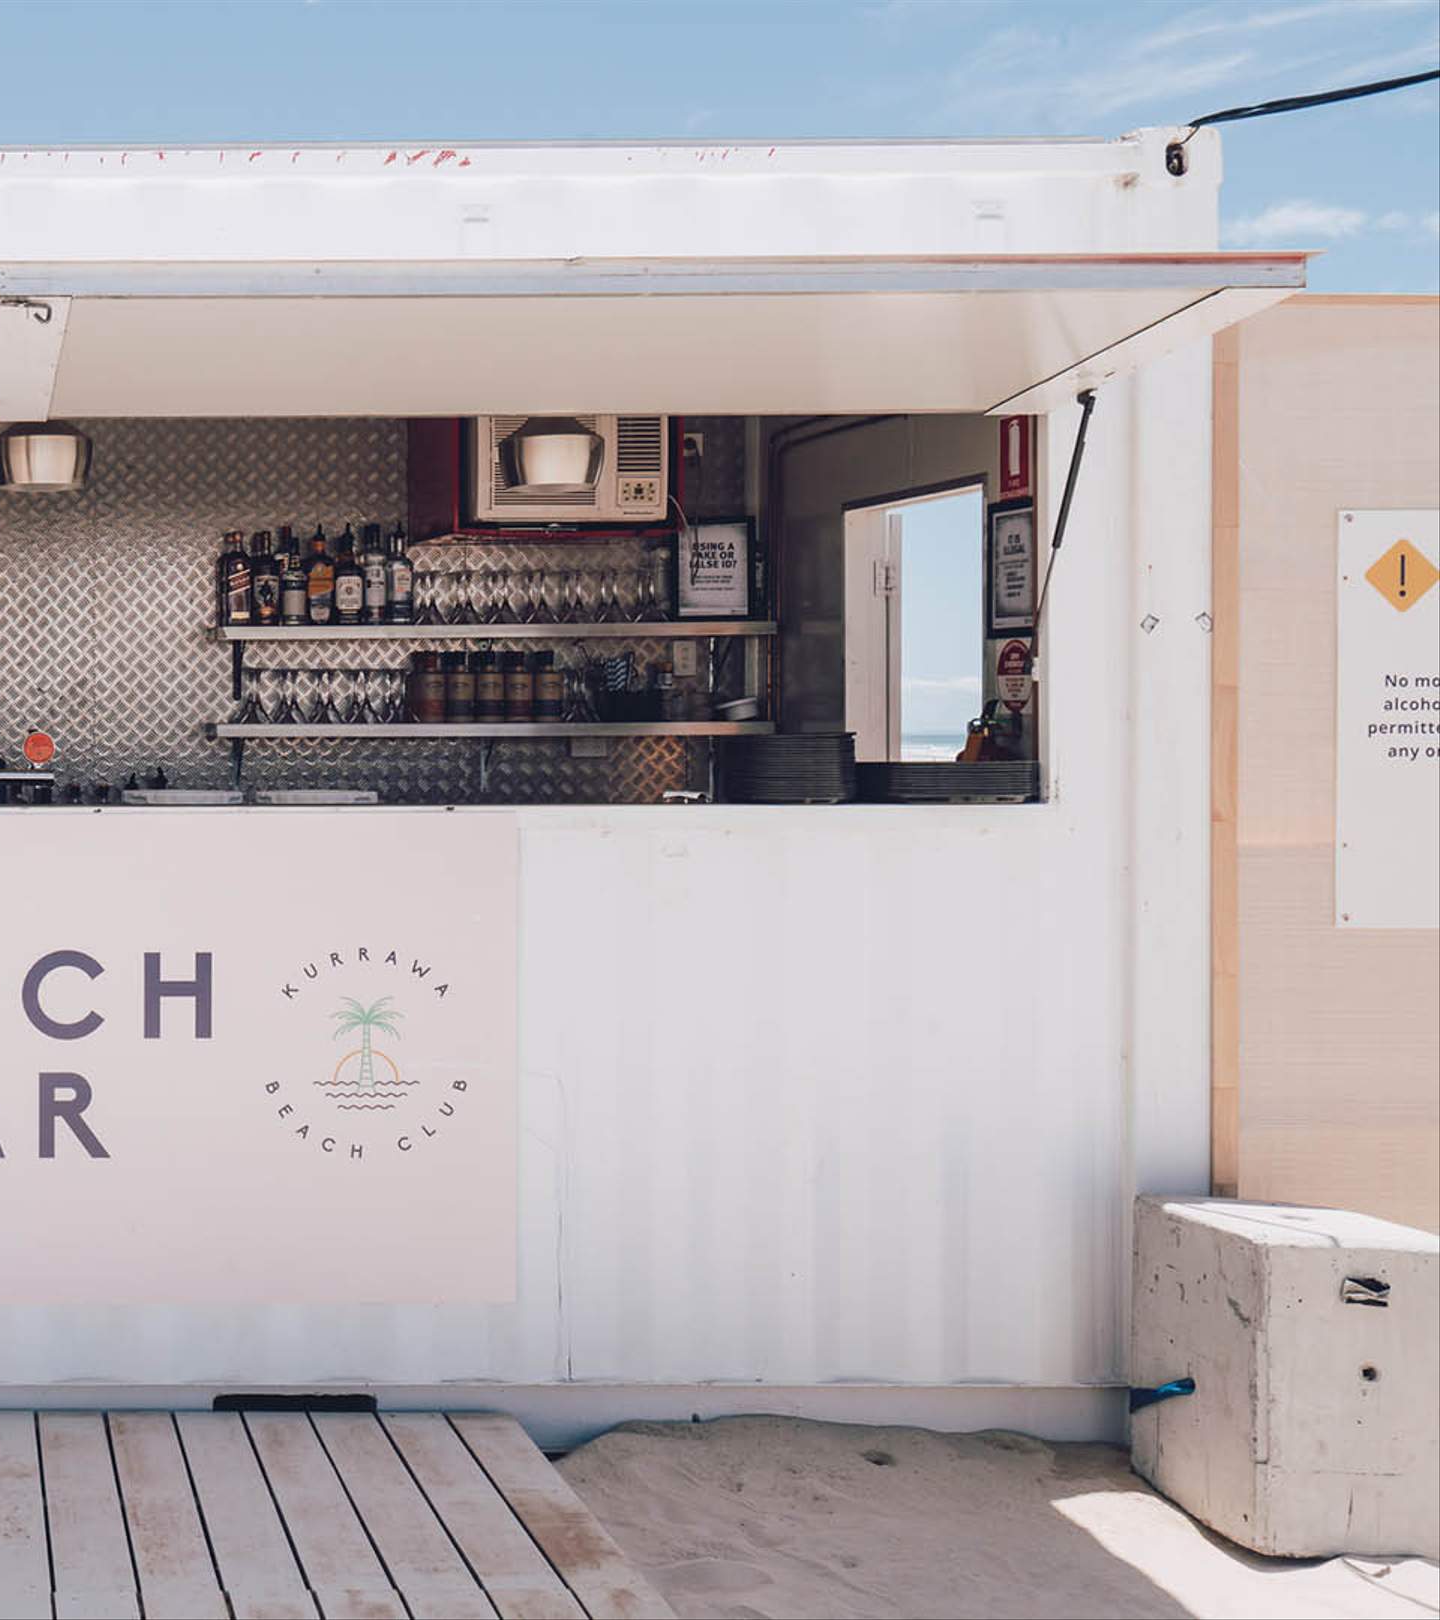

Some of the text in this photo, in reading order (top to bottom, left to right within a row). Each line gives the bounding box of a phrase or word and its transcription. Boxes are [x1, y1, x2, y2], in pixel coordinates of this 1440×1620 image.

[1385, 674, 1409, 688] No
[1388, 746, 1419, 761] any
[280, 947, 449, 999] KURRAWA
[265, 1079, 467, 1159] BEACH CLUB
